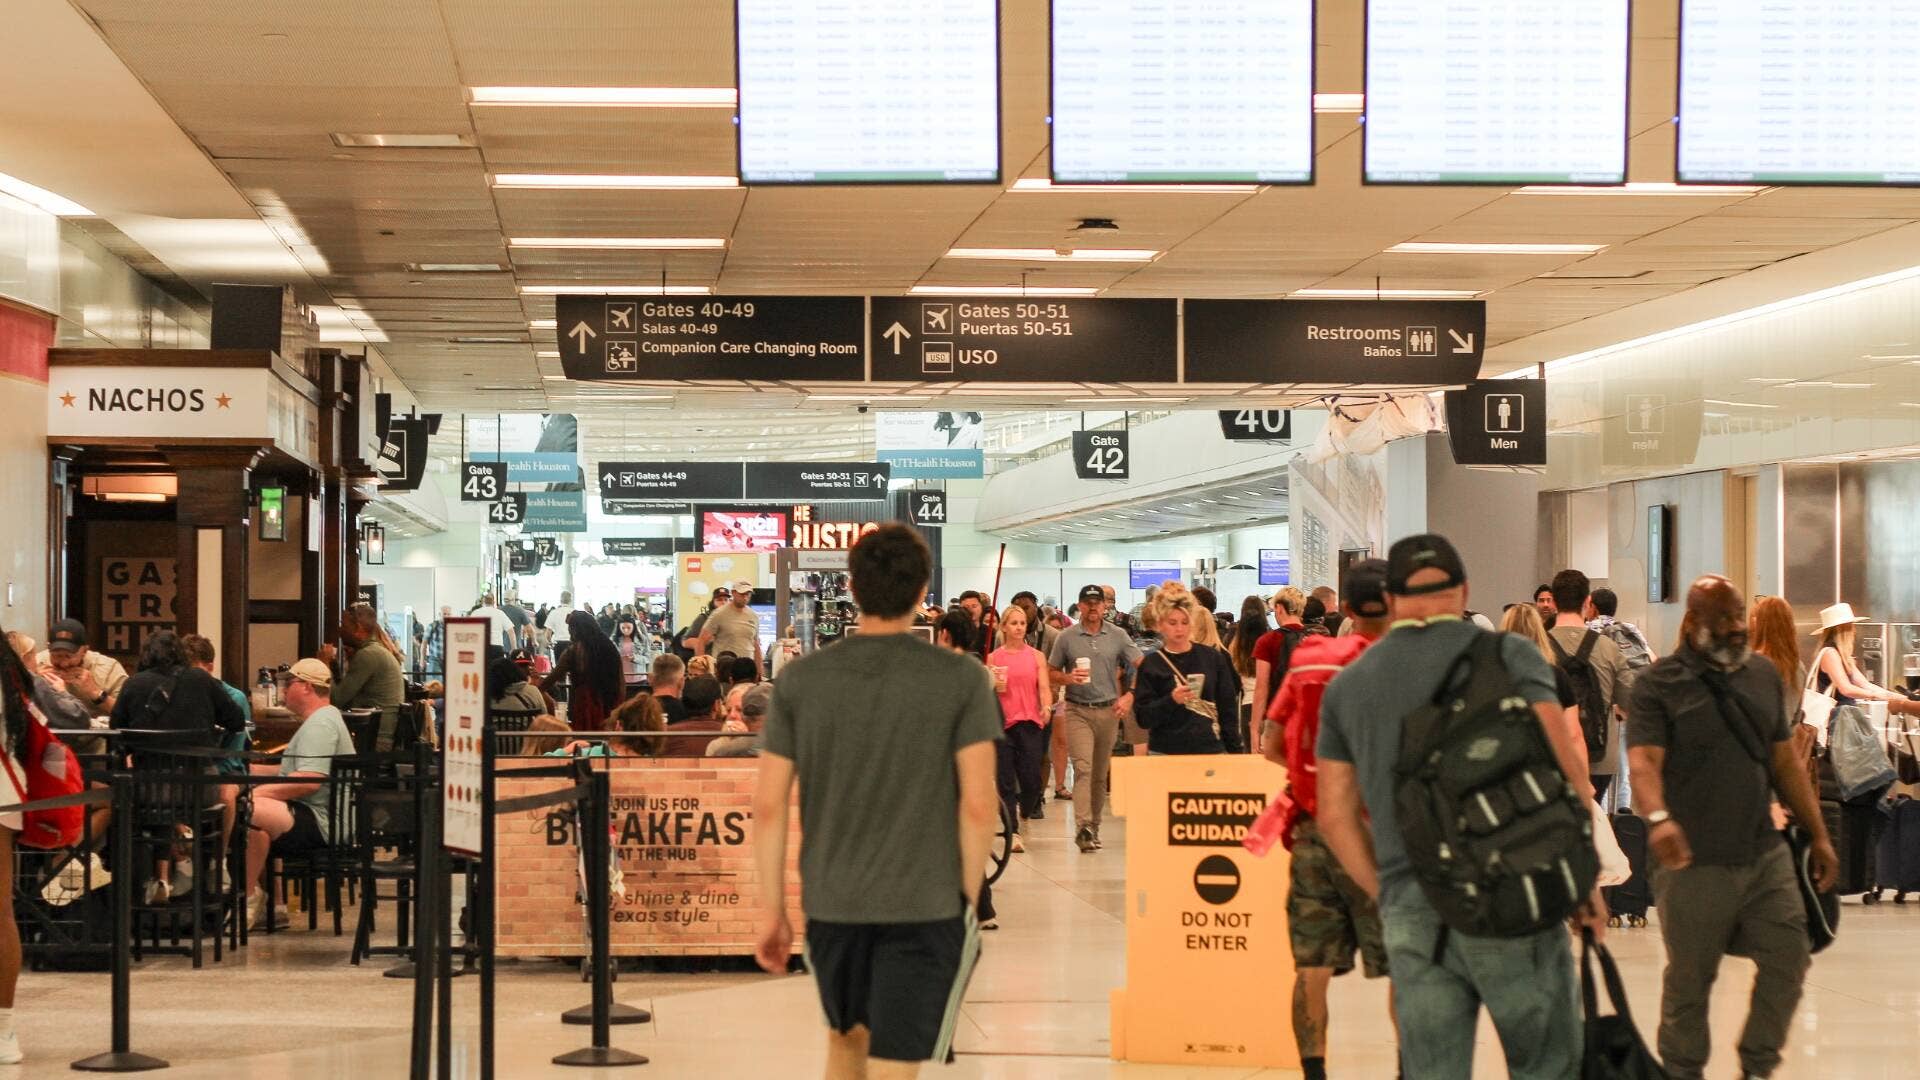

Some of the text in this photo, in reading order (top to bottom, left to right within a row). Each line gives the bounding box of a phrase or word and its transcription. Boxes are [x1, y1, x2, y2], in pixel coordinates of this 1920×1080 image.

[642, 303, 755, 318] Gates 40-49
[958, 304, 1069, 318] Gates 50-51
[642, 324, 718, 335] Salas 40-49
[960, 323, 1073, 336] Puertas 50-51
[1307, 326, 1402, 341] Restrooms
[642, 342, 857, 357] Companion Care Changing Room
[1363, 345, 1402, 357] Baños
[958, 350, 998, 365] USO
[88, 388, 205, 412] NACHOS
[1234, 410, 1285, 433] 40
[1090, 435, 1120, 446] Gate
[1491, 438, 1518, 449] Men
[533, 461, 571, 471] Houston
[941, 458, 976, 468] Houston
[1086, 447, 1125, 474] 42
[468, 465, 493, 475] Gate
[636, 472, 687, 480] Gates 44-49
[801, 472, 851, 480] Gates 50-51
[464, 475, 497, 498] 43
[921, 494, 941, 502] Gate
[491, 503, 519, 521] 45
[793, 505, 811, 521] HE
[917, 503, 945, 520] 44
[612, 798, 700, 811] JOIN US FOR
[1170, 798, 1263, 816] CAUTION
[546, 812, 753, 846] BAKFAS
[1171, 824, 1249, 841] CUIDAD
[617, 848, 697, 861] AT THE HUB
[623, 890, 674, 906] shine
[680, 890, 693, 905] &
[698, 890, 740, 905] dine
[613, 909, 710, 927] exas style
[1181, 911, 1252, 928] DO NOT
[1185, 934, 1248, 951] ENTER
